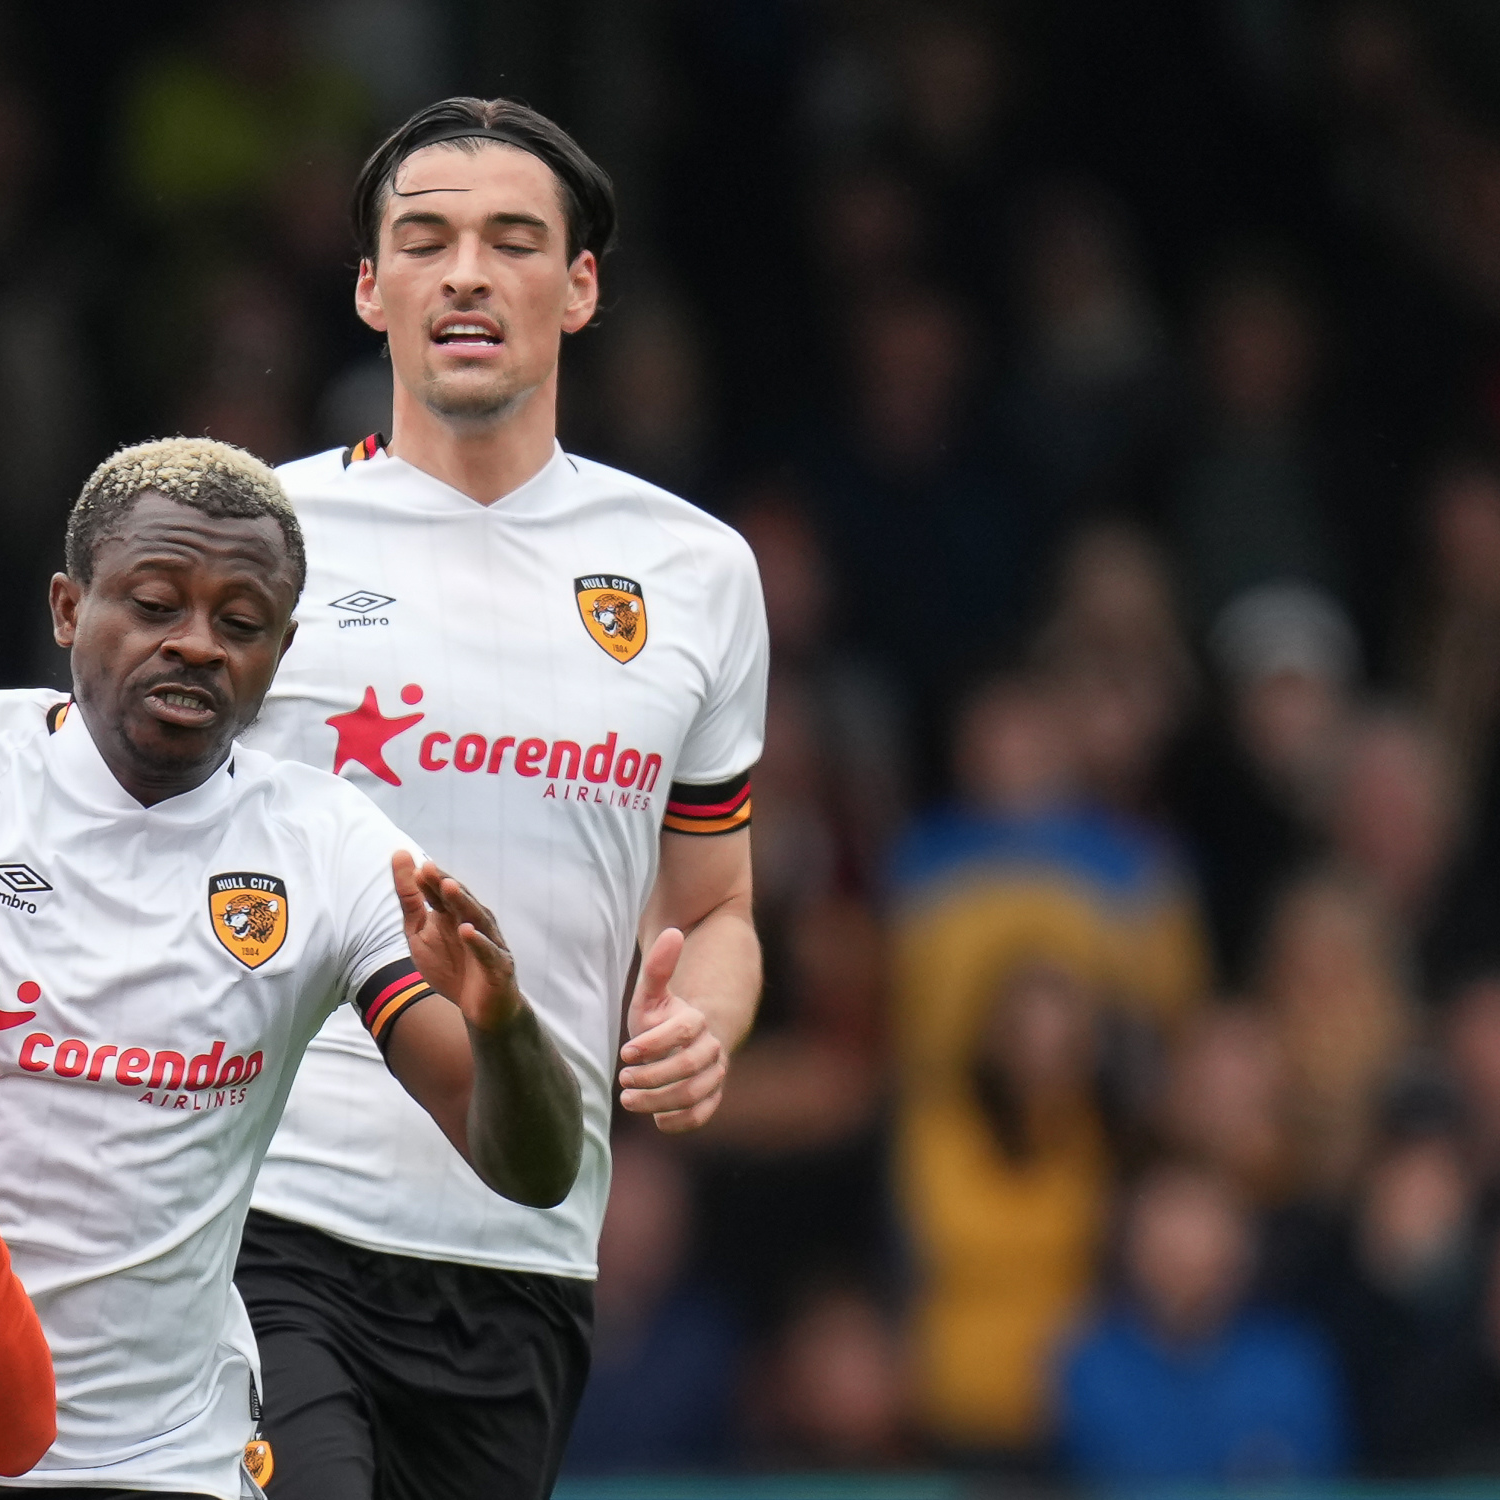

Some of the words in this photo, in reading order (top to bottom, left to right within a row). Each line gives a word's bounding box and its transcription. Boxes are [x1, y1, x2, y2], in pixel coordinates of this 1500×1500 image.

[581, 577, 609, 590] HULL
[611, 578, 636, 593] CITY
[338, 614, 389, 629] umbro
[418, 731, 663, 793] corendon
[543, 783, 651, 812] AIRLINES
[216, 877, 246, 891] HULL
[250, 877, 277, 892] CITY
[18, 1032, 264, 1092] corendon
[138, 1087, 248, 1112] AIRLINES
